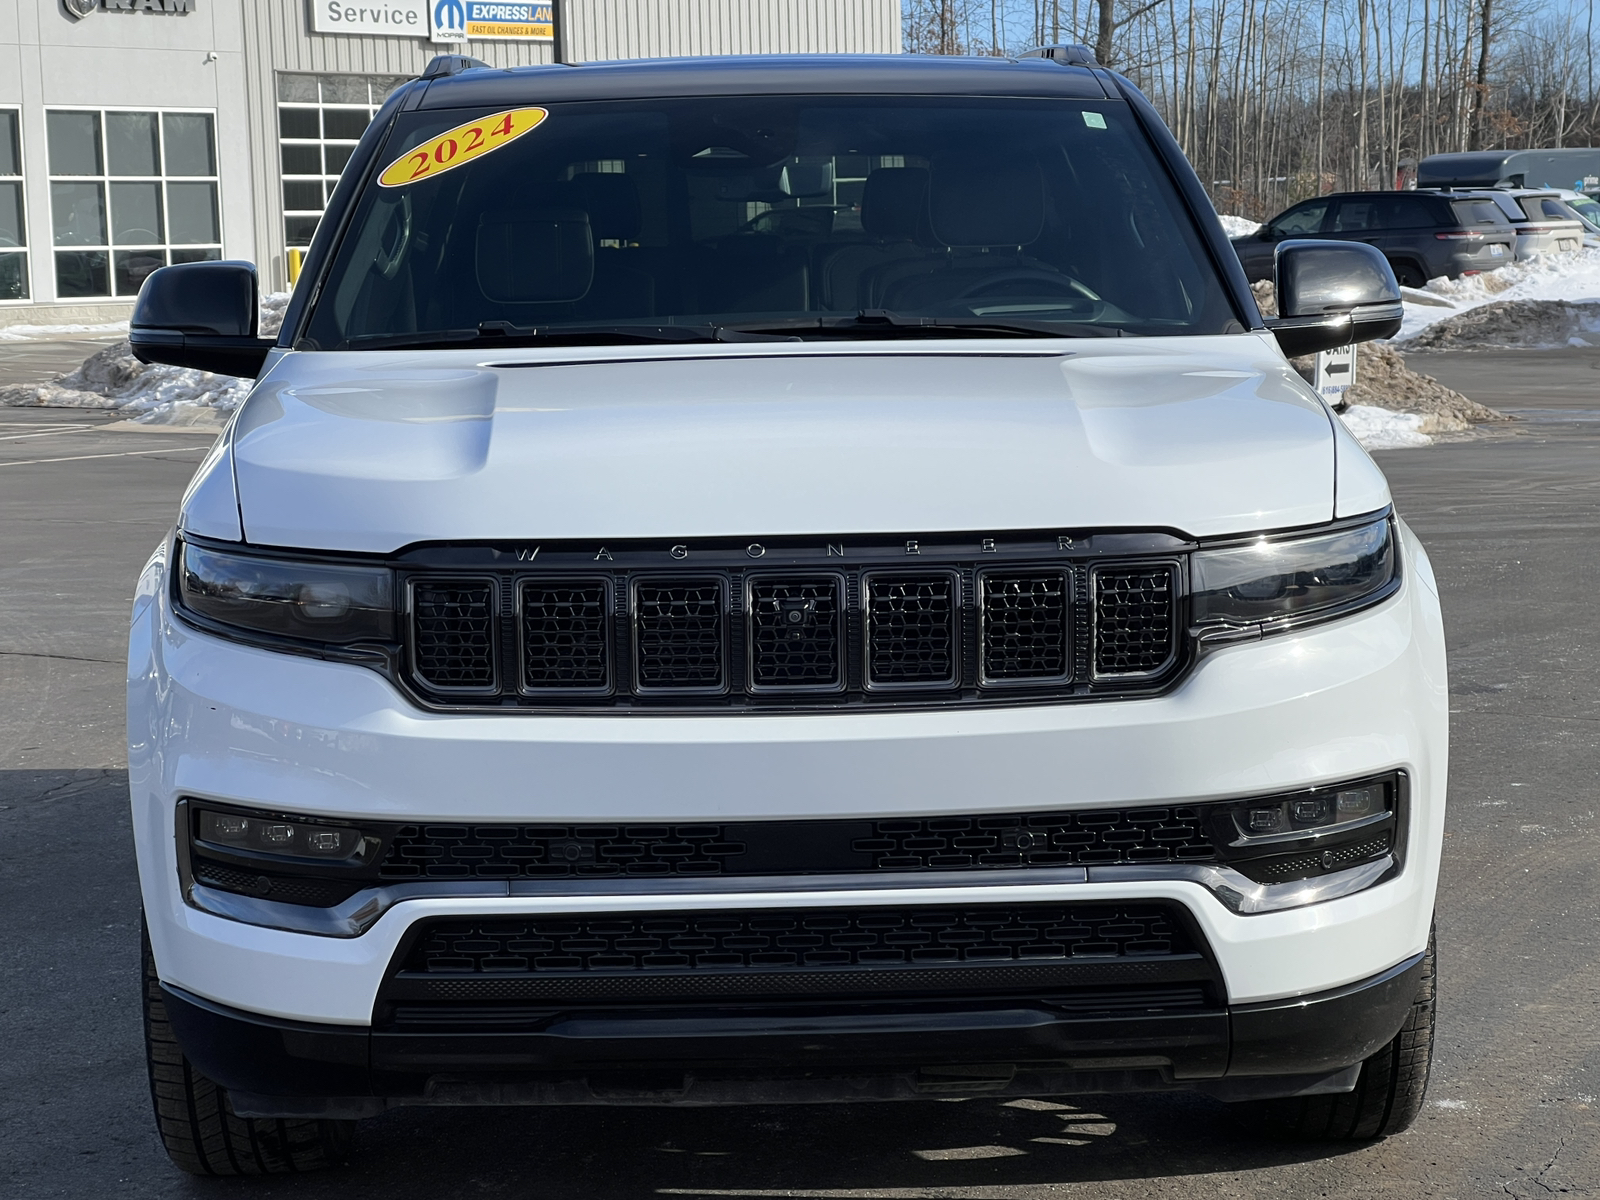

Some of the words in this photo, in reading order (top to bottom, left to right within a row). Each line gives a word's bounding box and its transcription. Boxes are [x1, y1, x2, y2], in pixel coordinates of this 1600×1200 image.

[327, 1, 418, 25] Service
[472, 25, 486, 34] FAST
[487, 25, 496, 34] OIL
[497, 26, 524, 35] CHANGES
[530, 27, 547, 36] MORE
[408, 113, 515, 180] 2024
[514, 535, 1075, 561] WAGONEER
